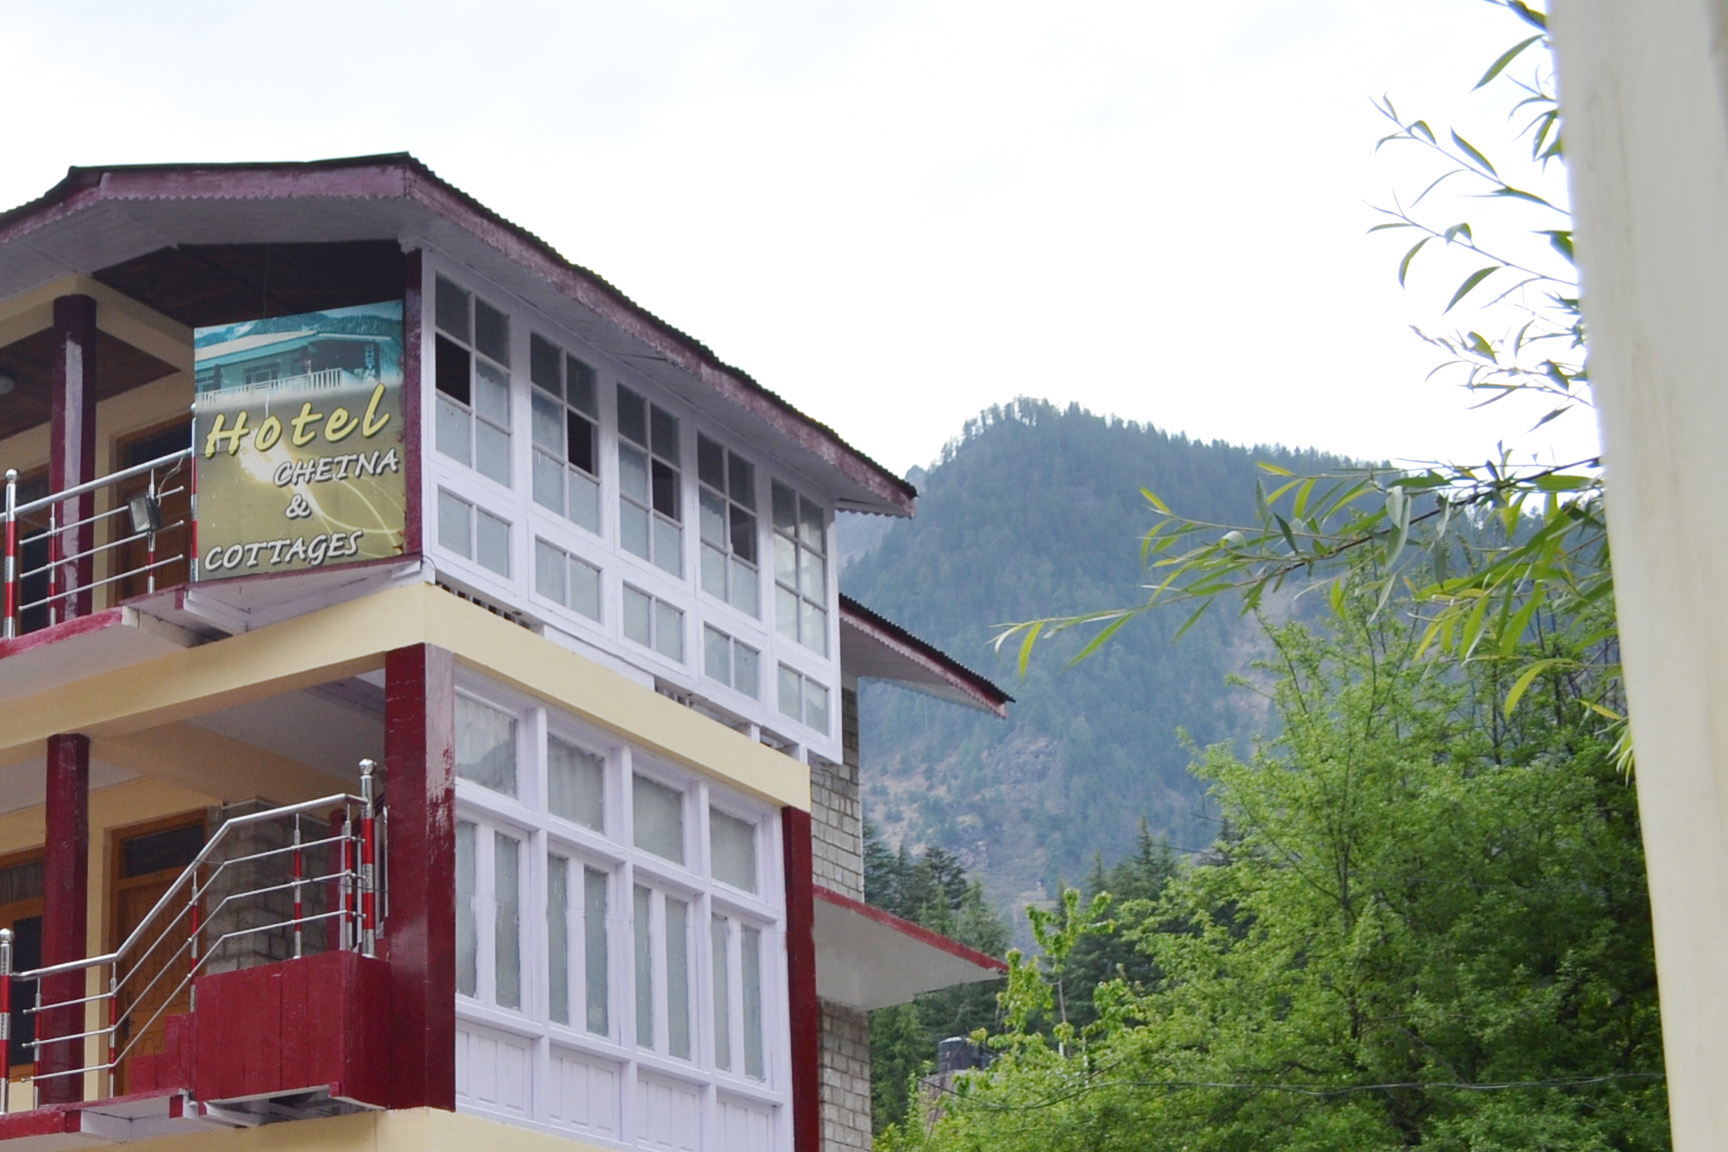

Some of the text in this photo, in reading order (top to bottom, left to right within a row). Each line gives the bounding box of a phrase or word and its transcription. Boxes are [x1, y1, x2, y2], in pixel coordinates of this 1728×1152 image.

[205, 383, 390, 458] Hotel
[274, 449, 399, 487] CHETNA
[285, 494, 312, 518] &
[204, 530, 363, 571] COTTAGES
